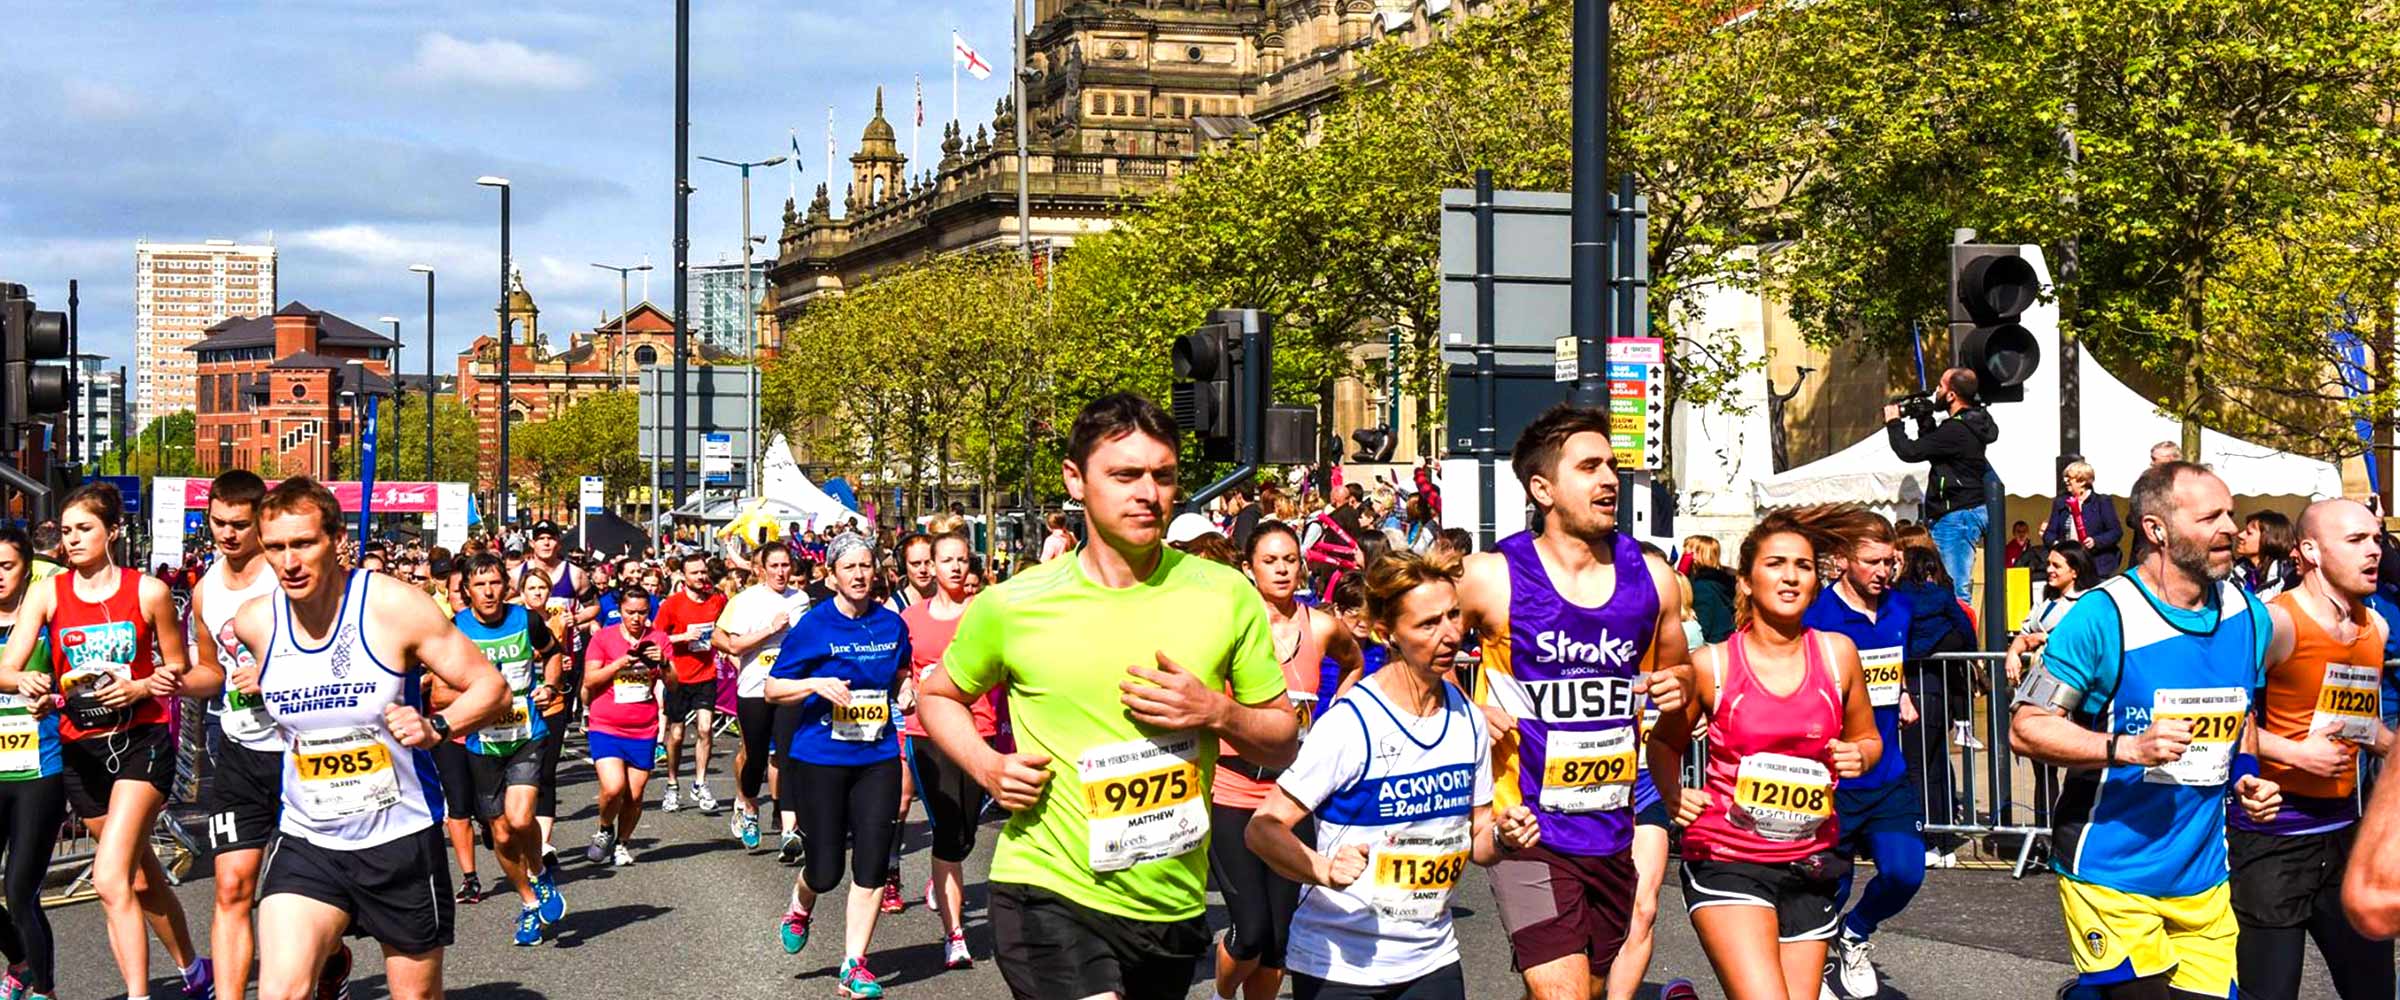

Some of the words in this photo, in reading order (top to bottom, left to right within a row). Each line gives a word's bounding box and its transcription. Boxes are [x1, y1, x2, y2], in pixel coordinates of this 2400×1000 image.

[1610, 416, 1634, 424] ELLOW
[481, 643, 520, 661] RAD
[829, 642, 851, 656] Jane
[1536, 628, 1637, 667] Stroke
[1863, 666, 1899, 683] 8766
[280, 696, 358, 715] RUNNERS
[2331, 690, 2375, 714] 12220
[842, 705, 884, 720] 10162
[2190, 745, 2208, 753] DAN
[308, 750, 373, 776] 7985
[1562, 757, 1625, 783] 8709
[1105, 769, 1188, 812] 9975
[1751, 781, 1825, 811] 12108
[1394, 798, 1431, 818] Road
[1748, 806, 1812, 821] Jasmine
[1128, 809, 1175, 828] MATTHEW
[209, 811, 238, 849] 14
[1392, 857, 1462, 886] 11368
[1413, 891, 1438, 900] SANDY
